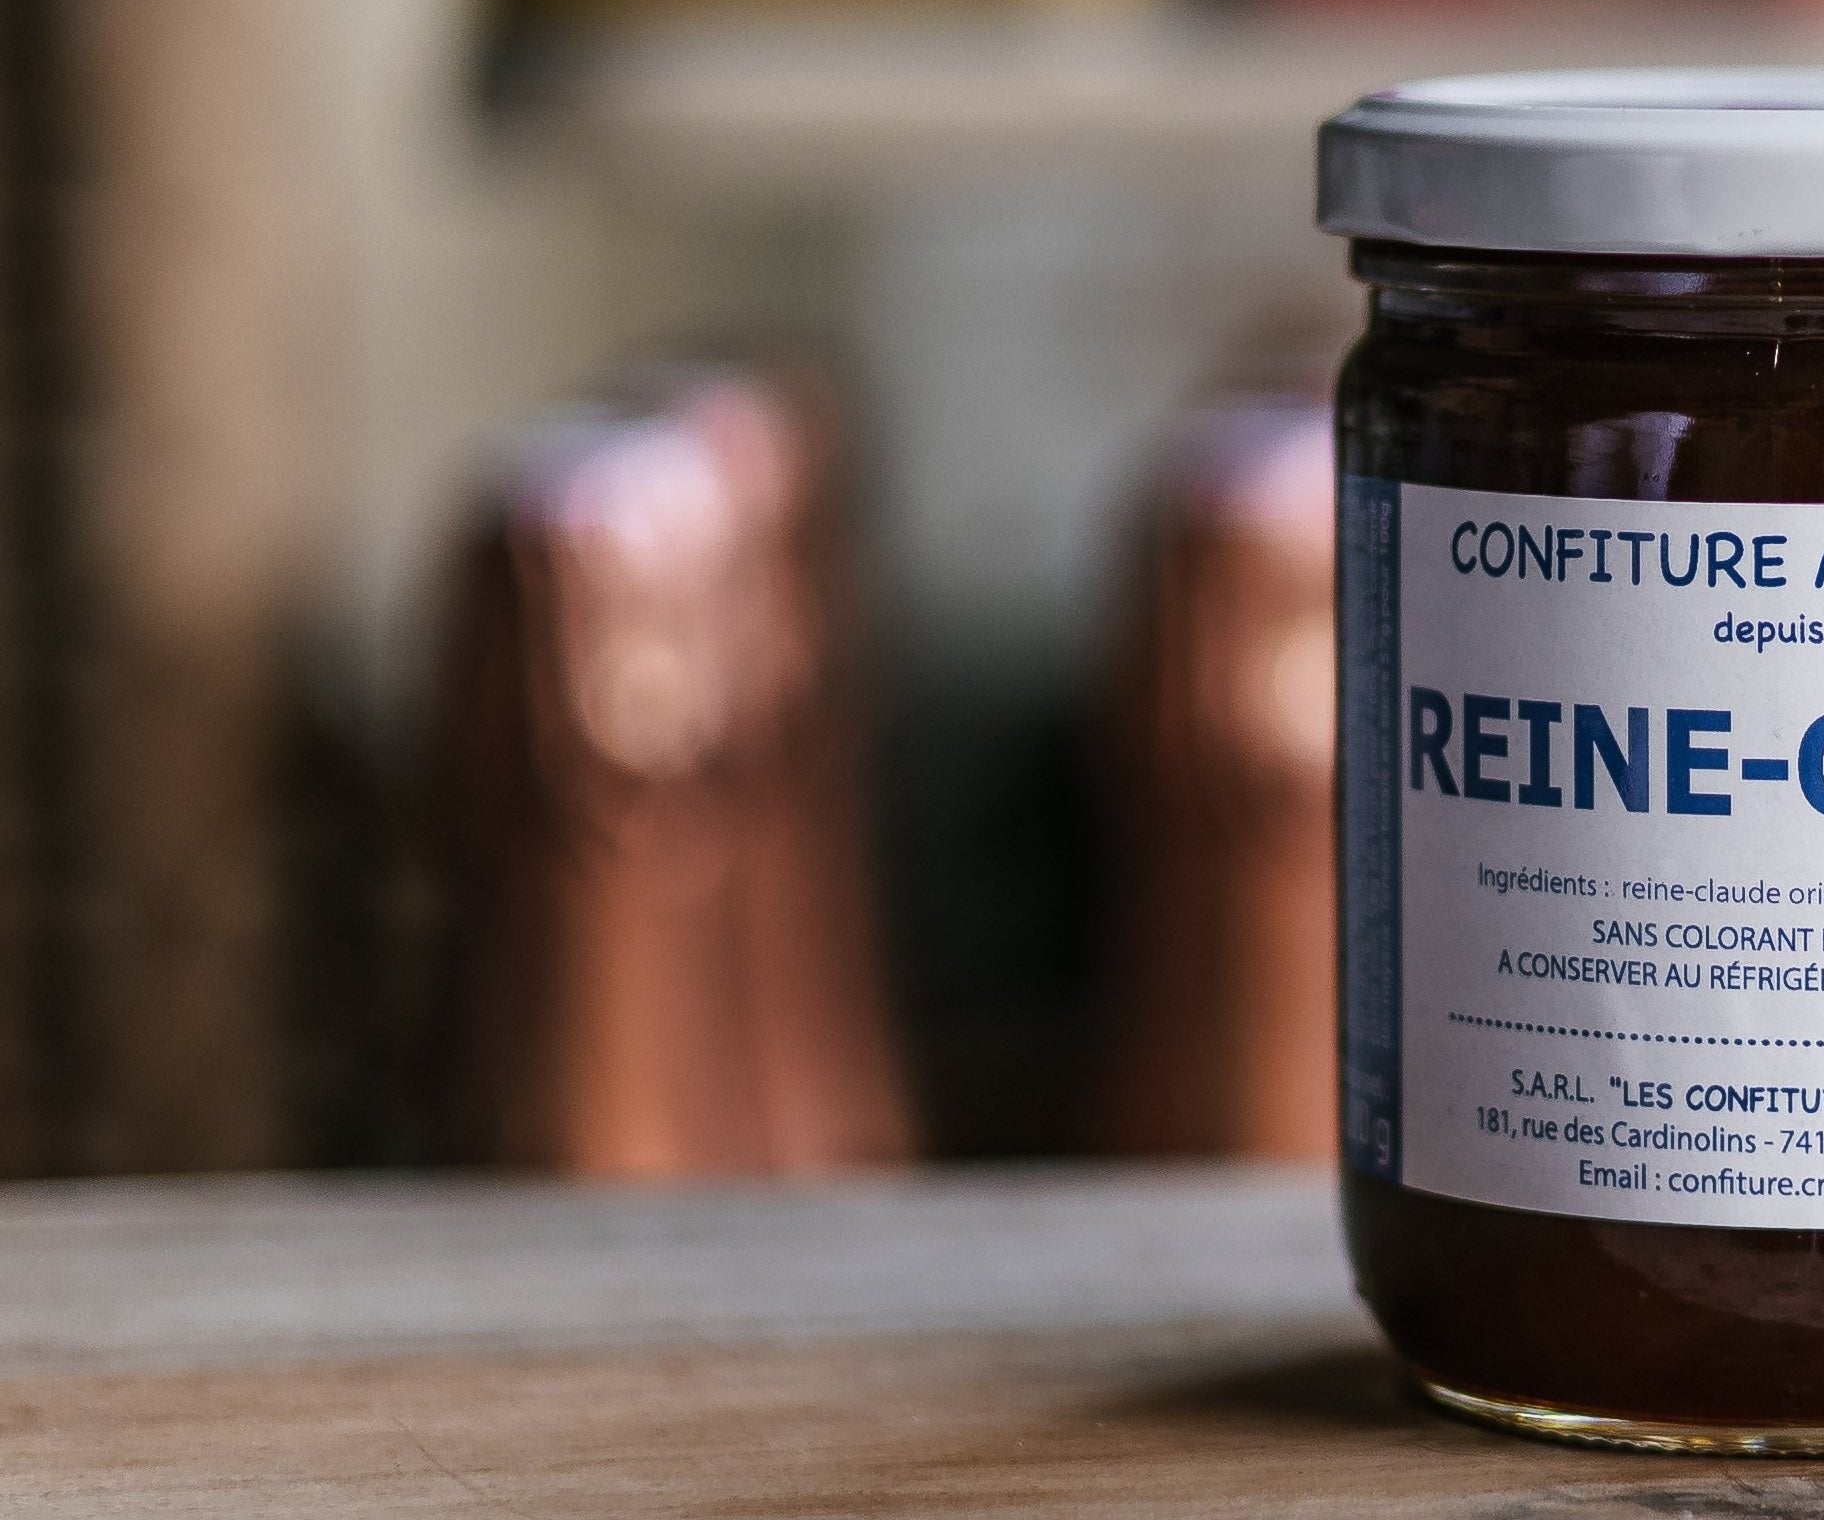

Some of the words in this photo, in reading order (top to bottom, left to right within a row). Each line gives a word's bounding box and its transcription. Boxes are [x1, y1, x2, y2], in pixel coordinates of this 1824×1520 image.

[1450, 520, 1788, 589] CONFITURE
[1713, 611, 1824, 654] depuis
[1477, 861, 1597, 897] Ingrédients
[1622, 876, 1781, 905] reine-claude
[1592, 919, 1658, 948] SANS
[1665, 923, 1815, 952] COLORANT
[1497, 948, 1514, 975] A
[1517, 951, 1658, 987] CONSERVER
[1664, 962, 1701, 989] AU
[1511, 1068, 1595, 1104] S.A.R.L.
[1609, 1075, 1674, 1110] "LES
[1476, 1105, 1518, 1140] 181,
[1521, 1117, 1559, 1142] rue
[1563, 1115, 1605, 1146] des
[1611, 1120, 1757, 1154] Cardinolins
[1579, 1159, 1647, 1190] Email
